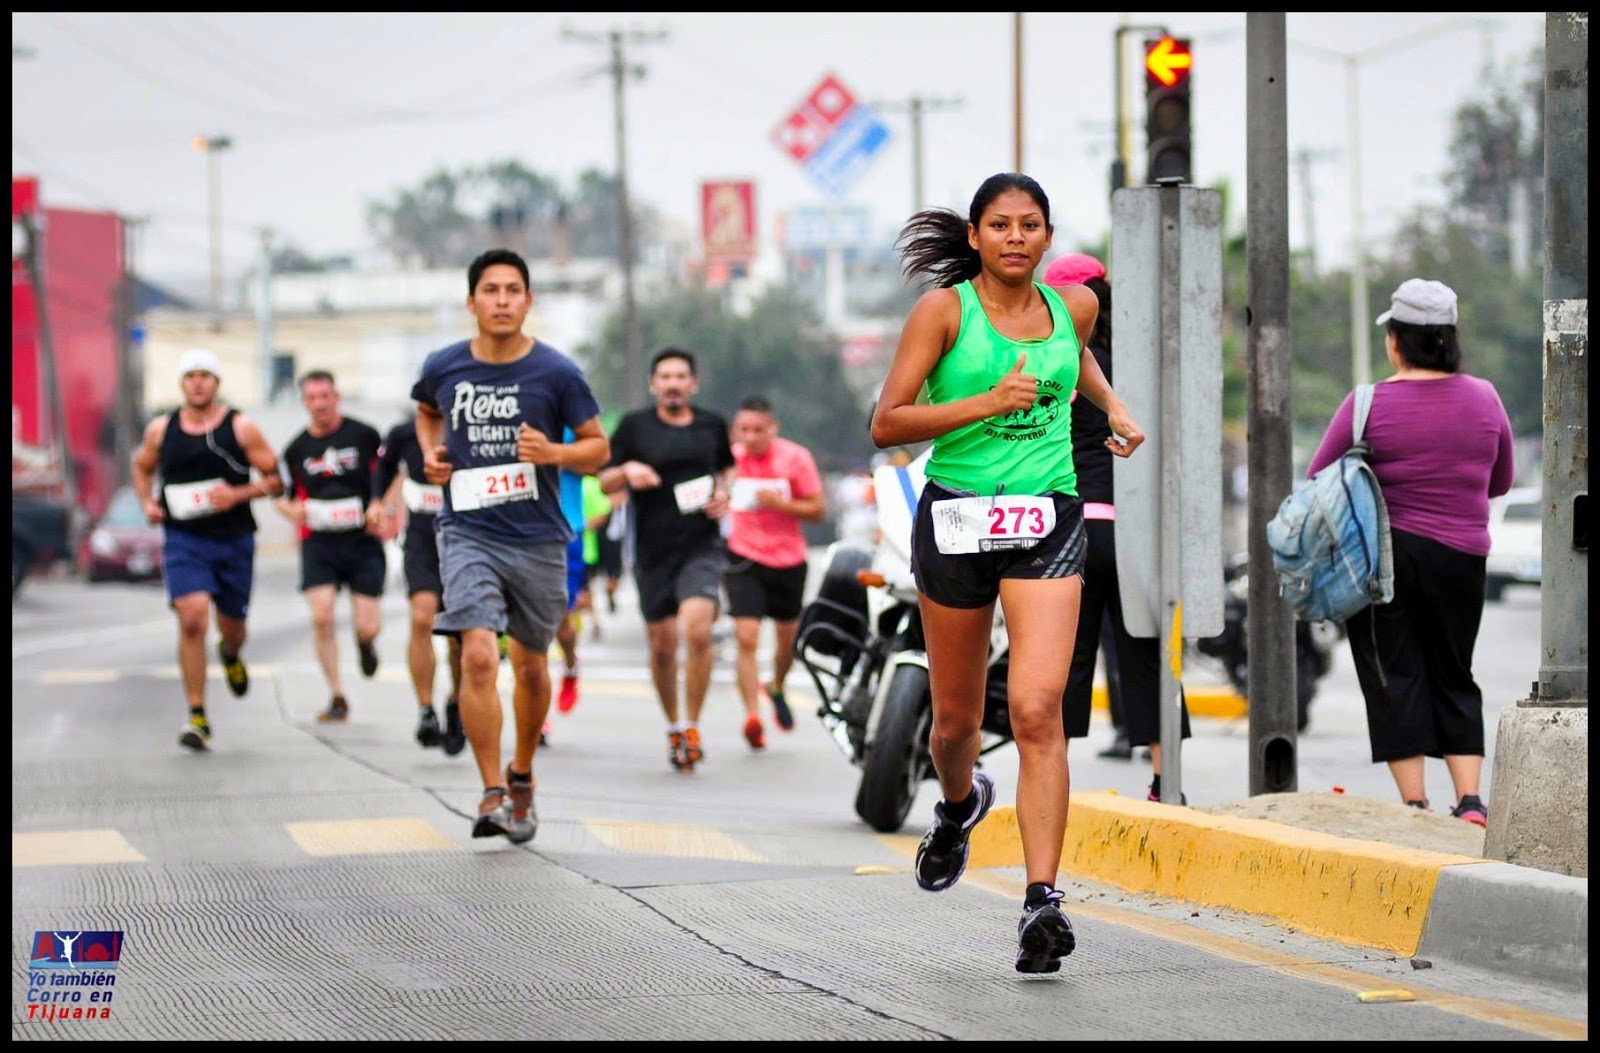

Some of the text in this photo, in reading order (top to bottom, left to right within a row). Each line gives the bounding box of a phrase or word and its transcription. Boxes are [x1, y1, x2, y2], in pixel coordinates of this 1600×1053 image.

[450, 381, 521, 431] Aero
[467, 425, 522, 442] EIGHTY
[486, 472, 527, 494] 214
[988, 507, 1045, 535] 273
